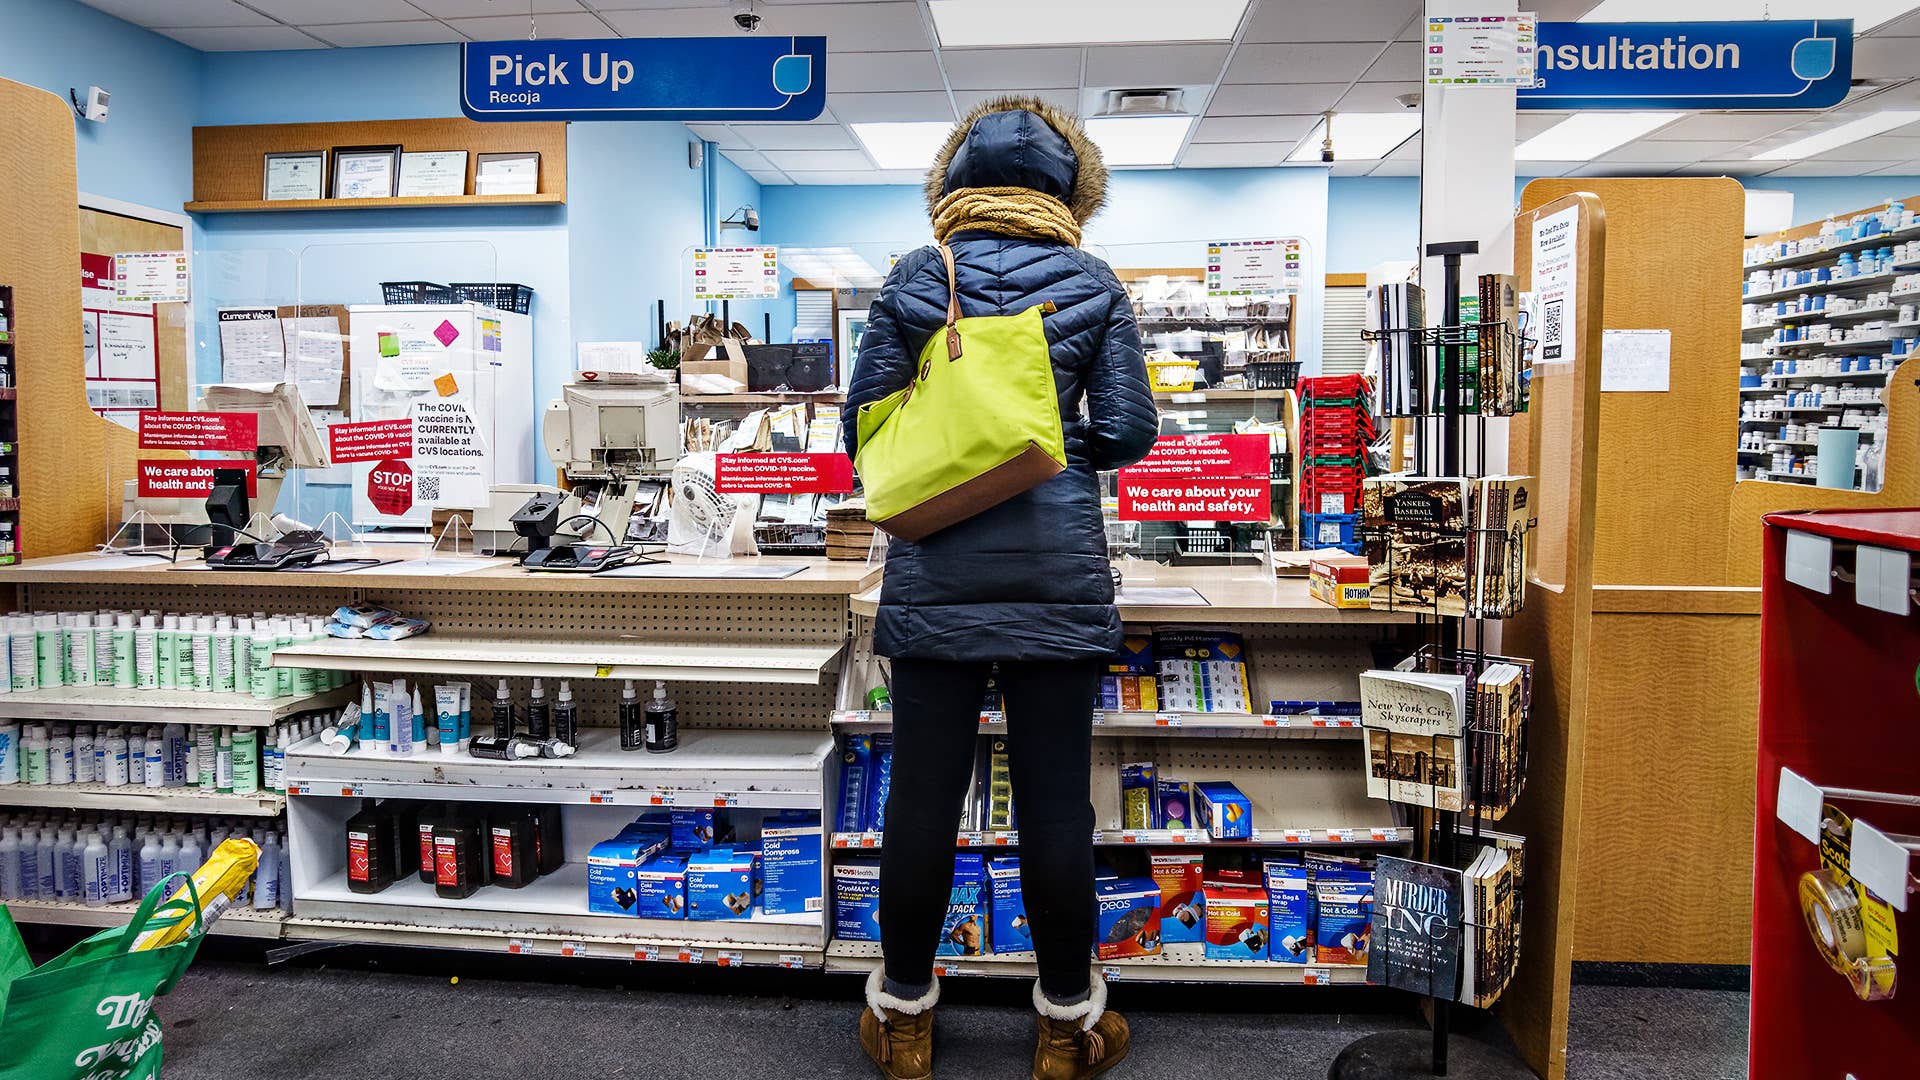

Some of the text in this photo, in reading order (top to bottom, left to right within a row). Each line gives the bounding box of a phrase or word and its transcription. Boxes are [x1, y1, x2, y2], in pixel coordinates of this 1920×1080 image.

[1538, 36, 1740, 71] nsultation
[489, 52, 635, 92] Pick Up
[489, 90, 541, 106] Recoja
[221, 312, 273, 320] Current Week
[418, 403, 466, 412] The COVI
[144, 415, 157, 423] Stay
[418, 415, 454, 423] vaccine
[455, 415, 464, 423] is
[334, 427, 348, 436] Stay
[348, 425, 377, 434] informed
[384, 423, 412, 431] CVS.com
[418, 425, 475, 434] CURRENTLY
[335, 435, 353, 443] about
[364, 432, 394, 441] COVID-19
[418, 436, 471, 446] available at
[418, 446, 484, 457] CVS locations.
[721, 456, 737, 464] Stay
[144, 466, 222, 477] We care abou
[372, 470, 412, 486] STOP
[149, 479, 184, 489] health
[185, 479, 206, 489] and
[1126, 486, 1262, 499] We care about your
[1132, 500, 1255, 515] health and safety.
[1394, 498, 1431, 507] YANKEES
[1394, 507, 1433, 516] BASEBALL
[1344, 588, 1370, 600] HOTHAN
[1367, 699, 1452, 720] New York City
[1379, 711, 1441, 726] Skyscrapers
[1821, 838, 1851, 871] Scotc
[589, 874, 616, 882] Compress
[1282, 893, 1294, 901] Bag
[1383, 877, 1449, 917] MURDER
[953, 904, 976, 914] PACK
[1099, 899, 1131, 916] peas
[1320, 906, 1334, 914] Hot
[1341, 907, 1358, 915] Cold
[1381, 904, 1448, 940] INC
[1376, 945, 1396, 953] NEW
[1397, 950, 1424, 960] YORK
[1387, 941, 1425, 953] HIT MEN
